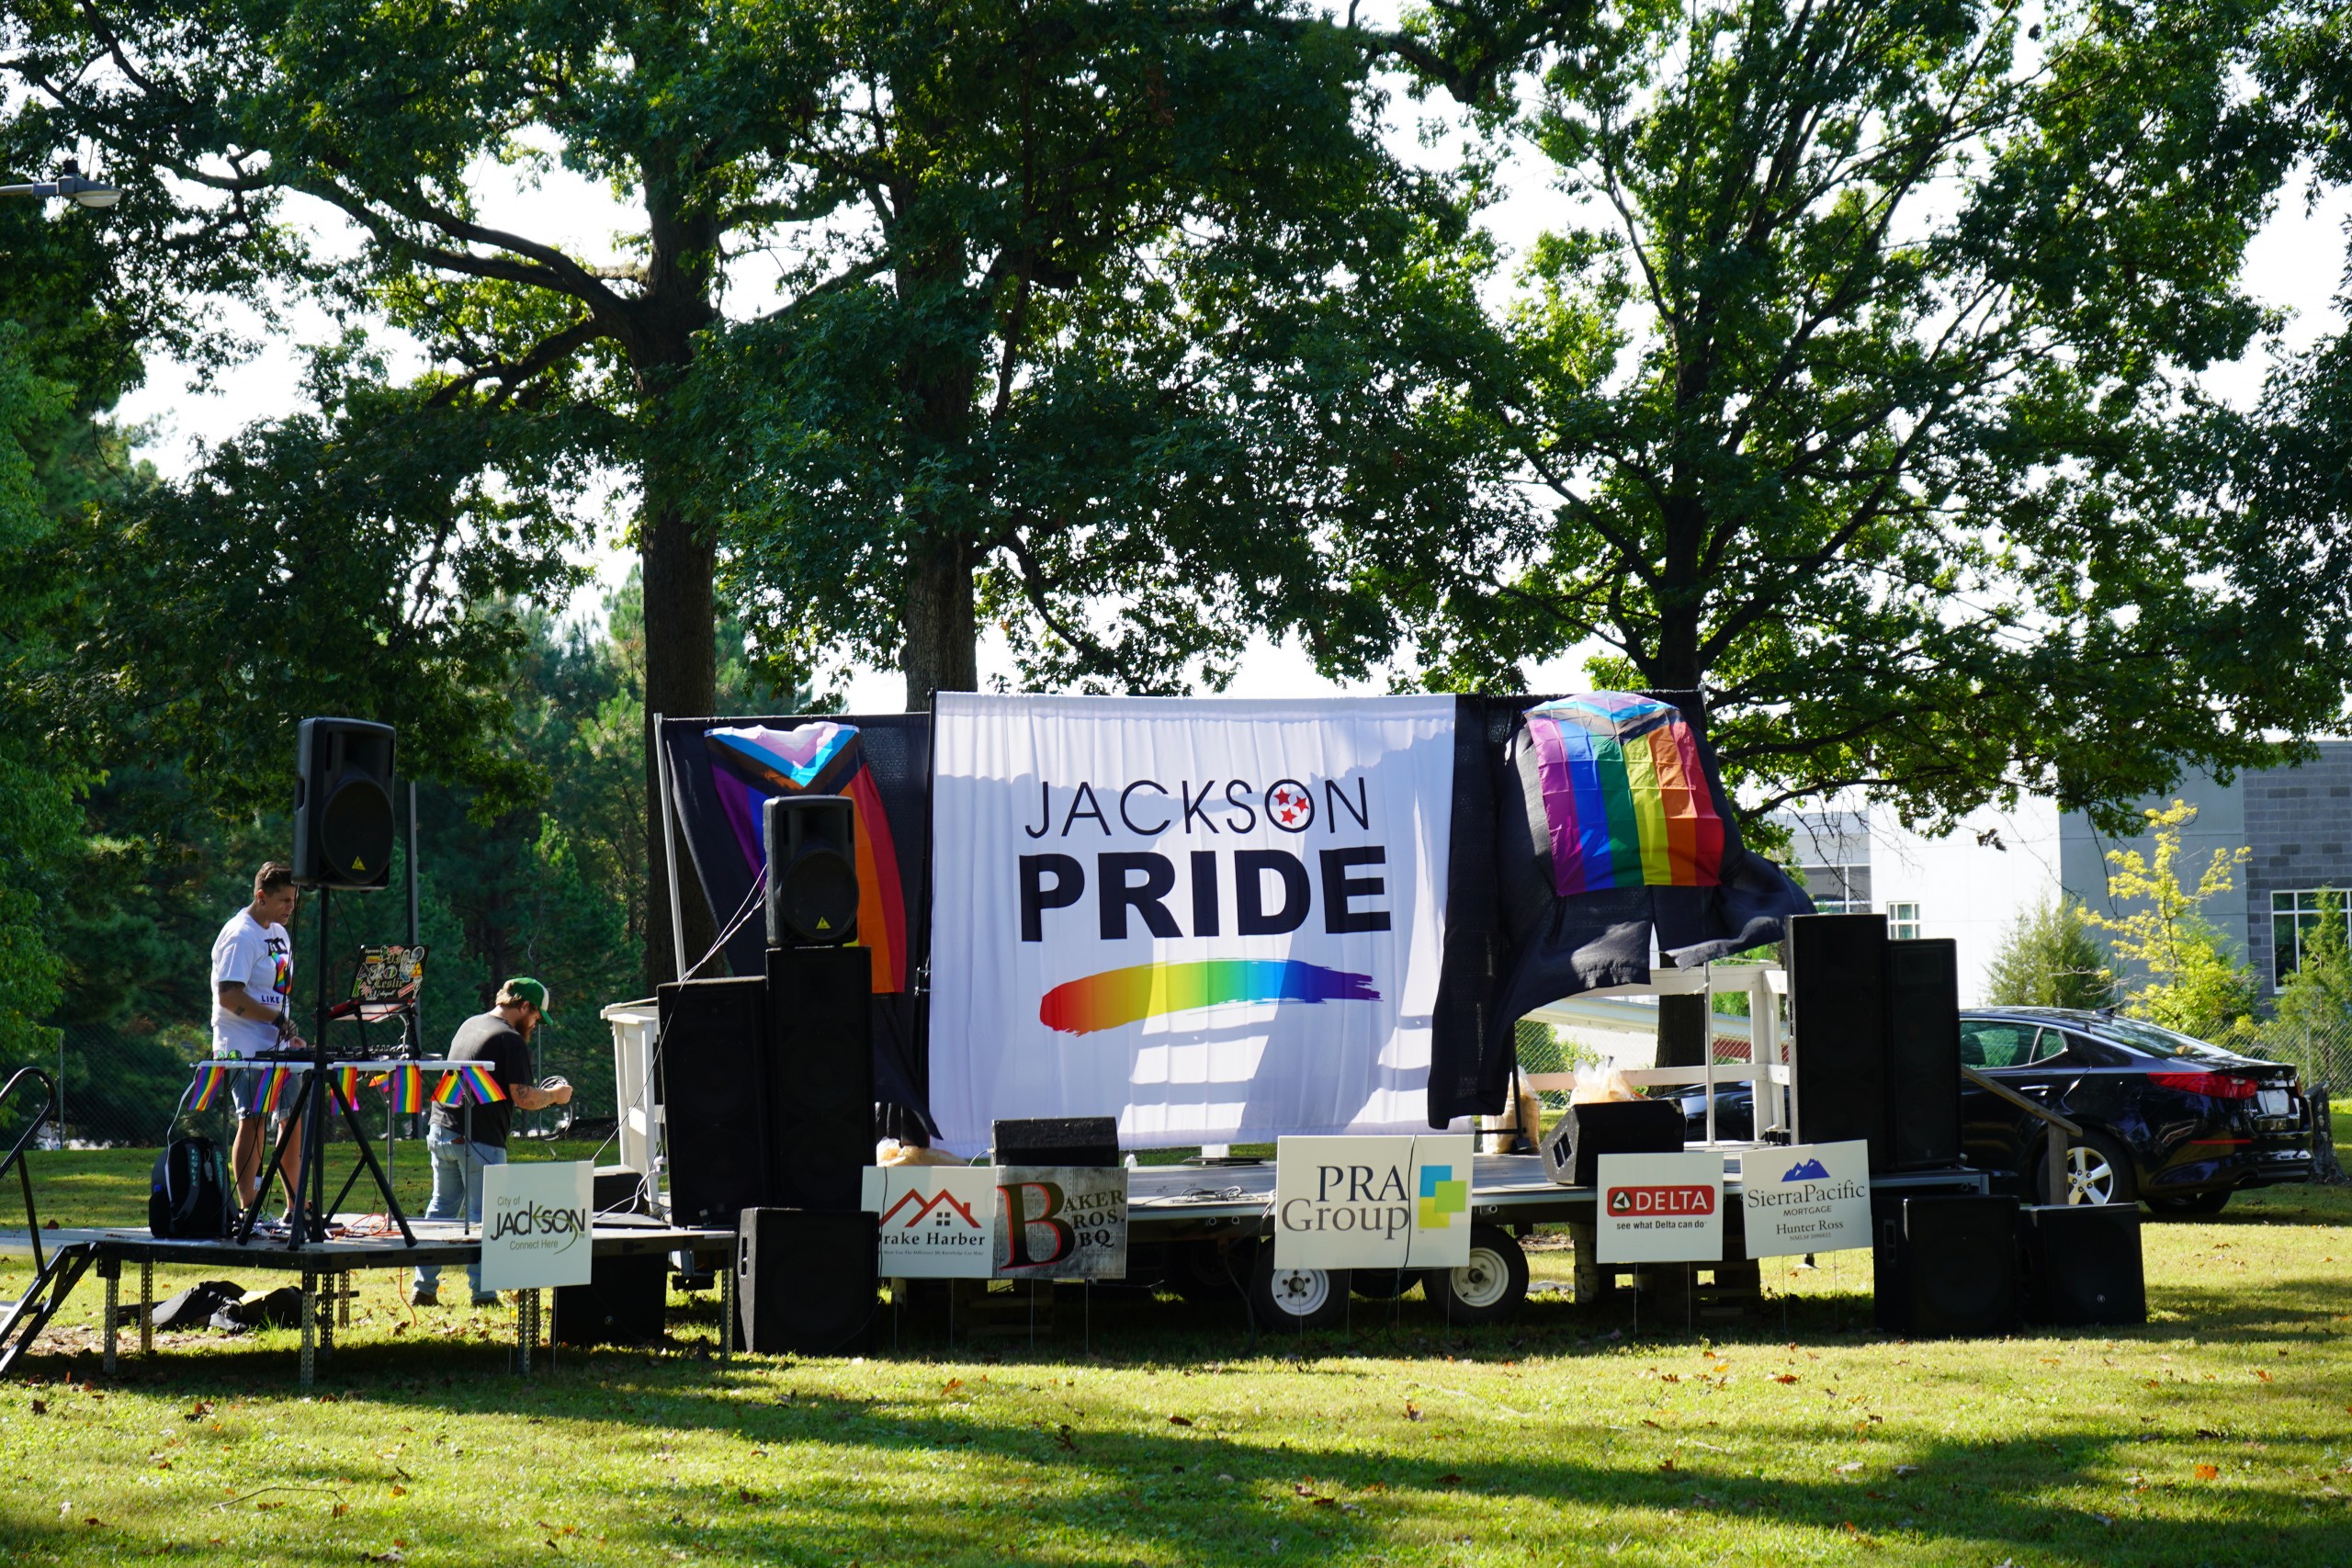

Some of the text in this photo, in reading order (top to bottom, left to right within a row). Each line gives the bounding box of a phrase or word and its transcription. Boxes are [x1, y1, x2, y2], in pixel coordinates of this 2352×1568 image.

[1024, 776, 1370, 840] JACKSON
[1018, 845, 1392, 942] PRIDE
[261, 995, 280, 1004] LIKE
[1316, 1164, 1408, 1202] PRA
[497, 1195, 521, 1208] City of
[1635, 1190, 1708, 1212] DELTA
[1747, 1179, 1866, 1208] SierraPacific
[1282, 1198, 1409, 1240] Group
[1783, 1205, 1832, 1217] MORTGAGE
[1616, 1222, 1631, 1230] see
[1633, 1221, 1653, 1229] what
[1655, 1220, 1676, 1229] Delta
[1694, 1220, 1704, 1228] do
[1776, 1219, 1844, 1235] Hunter Ross
[509, 1239, 559, 1250] Connect Here
[878, 1232, 986, 1246] rake Harber
